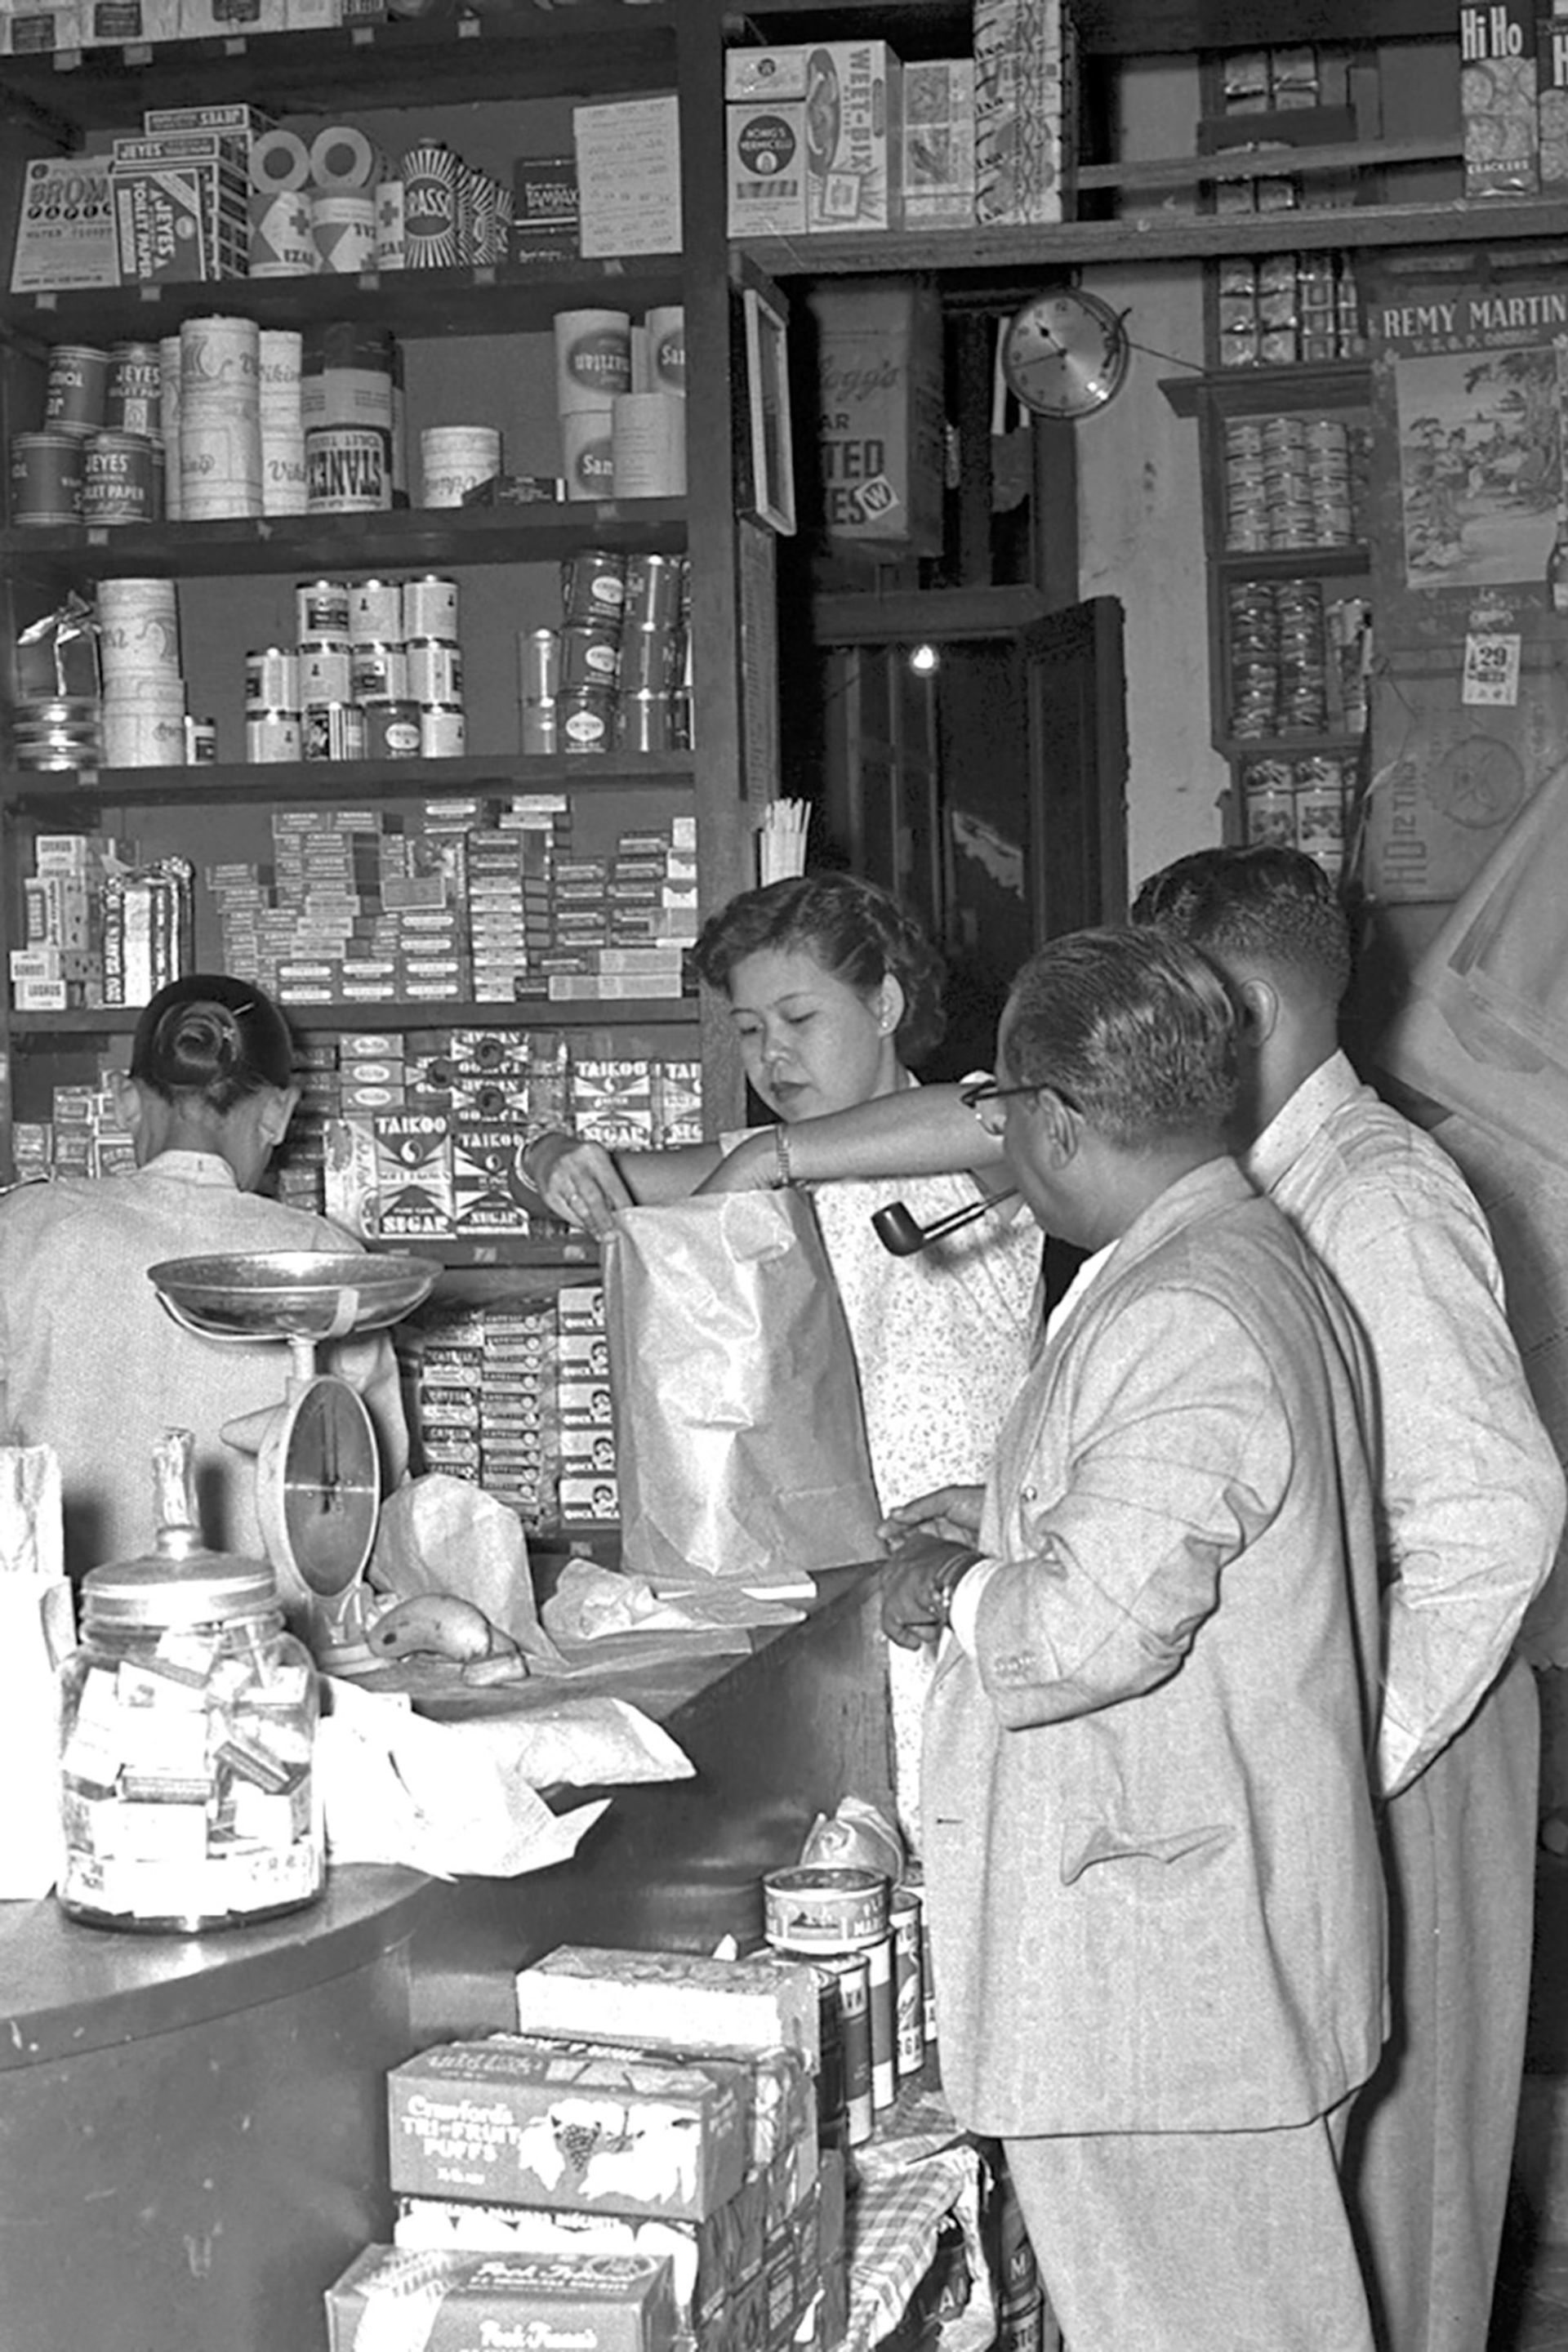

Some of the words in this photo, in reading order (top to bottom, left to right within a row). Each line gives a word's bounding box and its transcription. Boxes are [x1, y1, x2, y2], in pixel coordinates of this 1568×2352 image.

[154, 203, 176, 257] JEYES
[1383, 304, 1457, 339] REMY
[1468, 294, 1566, 330] MARTIN
[1478, 646, 1508, 666] 29
[575, 1061, 648, 1077] TAIKOO
[375, 1116, 447, 1134] TAIKOO
[461, 1134, 525, 1147] TAIKOO
[381, 1215, 449, 1233] SUGAR
[470, 1210, 519, 1225] SUGAR
